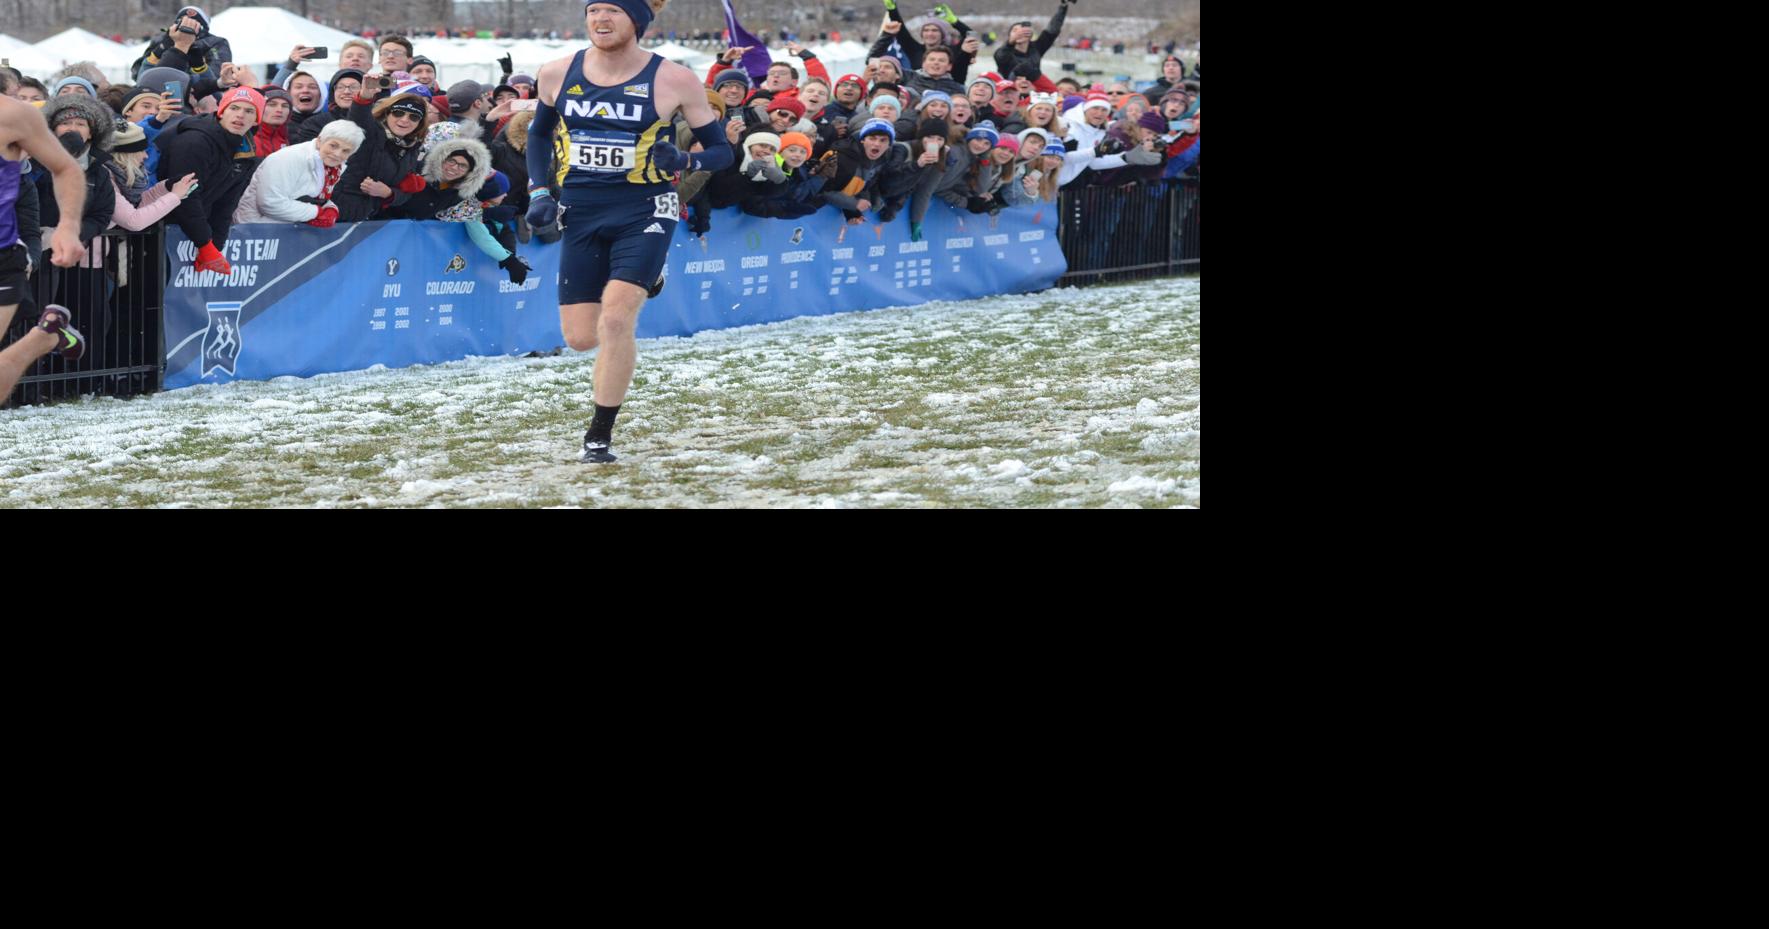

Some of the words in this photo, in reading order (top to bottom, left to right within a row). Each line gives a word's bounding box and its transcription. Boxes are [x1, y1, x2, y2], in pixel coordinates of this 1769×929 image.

[564, 99, 643, 121] NAU
[579, 145, 624, 168] 556
[245, 239, 279, 261] TEAM
[174, 264, 259, 287] CHAMPIONS
[383, 283, 401, 298] BYU
[426, 281, 475, 295] COLORADO
